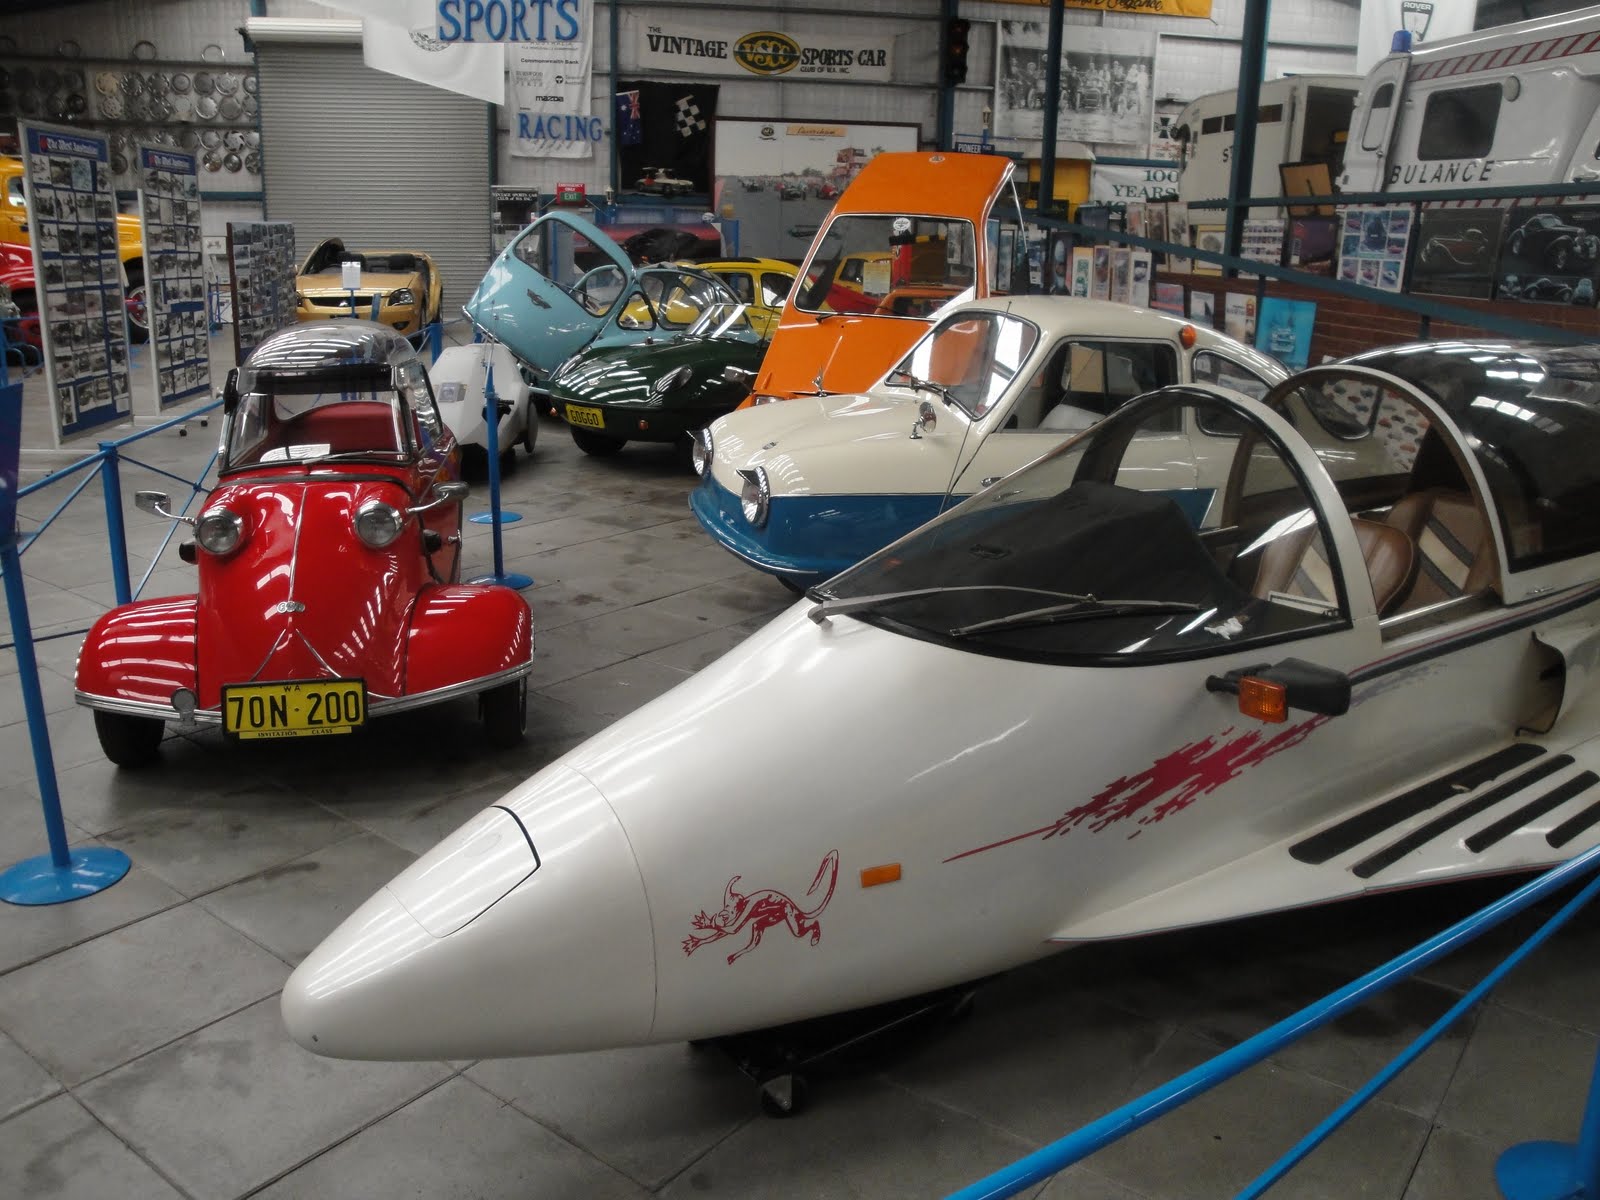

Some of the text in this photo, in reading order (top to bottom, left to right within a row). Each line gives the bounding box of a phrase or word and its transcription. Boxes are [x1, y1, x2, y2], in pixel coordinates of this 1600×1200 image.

[1403, 1, 1432, 10] ROVER
[438, 0, 579, 42] SPORTS
[646, 34, 728, 59] VINTAGE
[741, 39, 790, 67] VSCC
[801, 48, 887, 66] SPORTS CAR
[518, 112, 603, 142] RACING
[958, 143, 982, 154] PIONEER
[1143, 169, 1179, 183] 100
[1389, 160, 1495, 184] BULANCE
[564, 192, 577, 200] EXIT
[1112, 184, 1176, 200] YEARS
[570, 410, 599, 425] GOGGO
[257, 730, 298, 738] INVITATION
